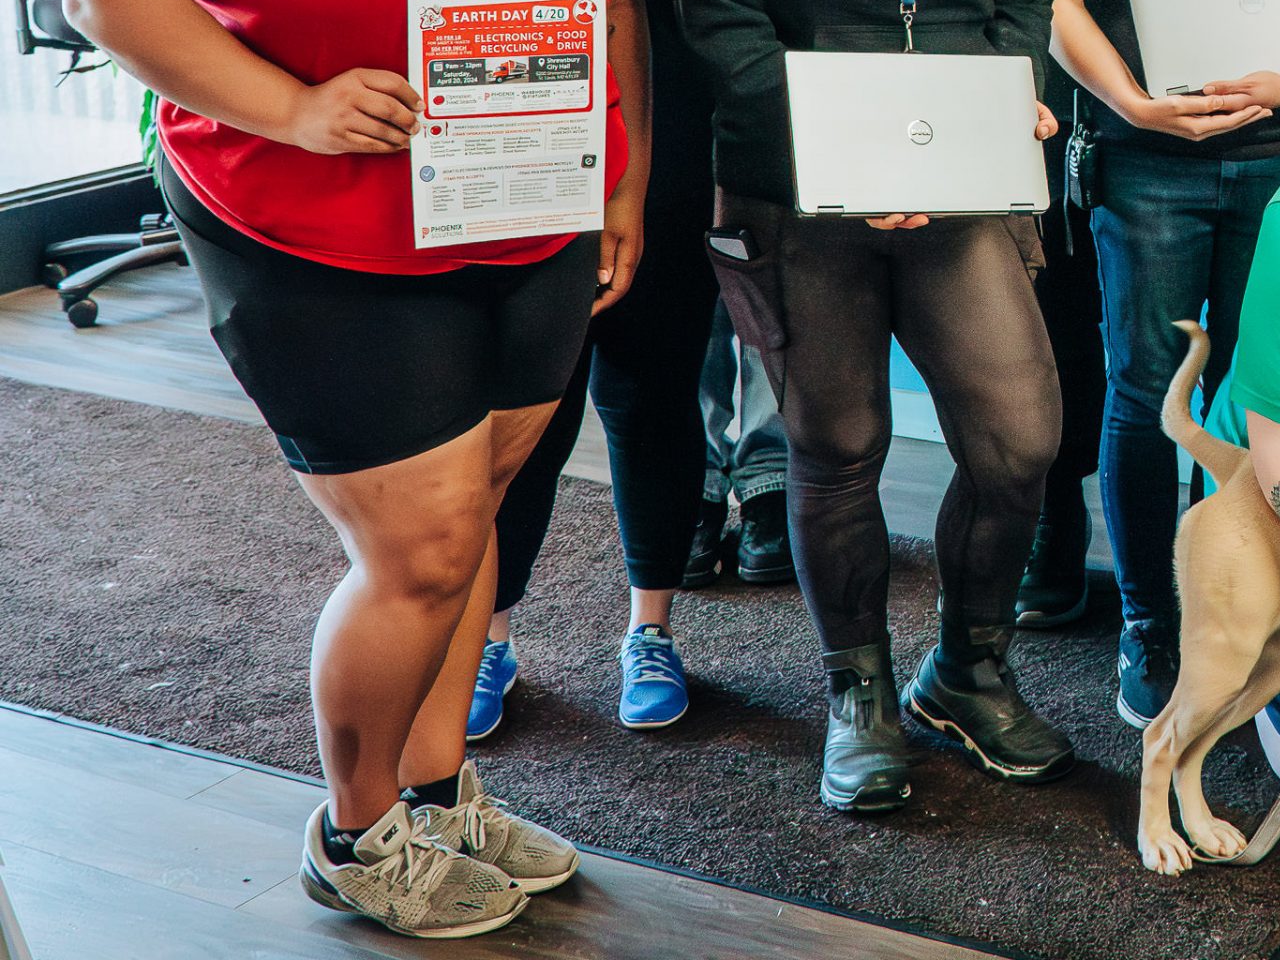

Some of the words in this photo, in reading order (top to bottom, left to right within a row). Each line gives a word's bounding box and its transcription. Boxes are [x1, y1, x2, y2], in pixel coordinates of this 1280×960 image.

[452, 10, 496, 23] EARTH
[501, 9, 529, 21] DAY
[535, 8, 565, 20] 4/20
[475, 32, 544, 43] ELECTRONICS
[547, 36, 554, 45] &
[557, 30, 587, 41] FOOD
[481, 43, 538, 54] RECYCLING
[557, 41, 587, 51] DRIVE
[431, 224, 462, 233] PHOENIX
